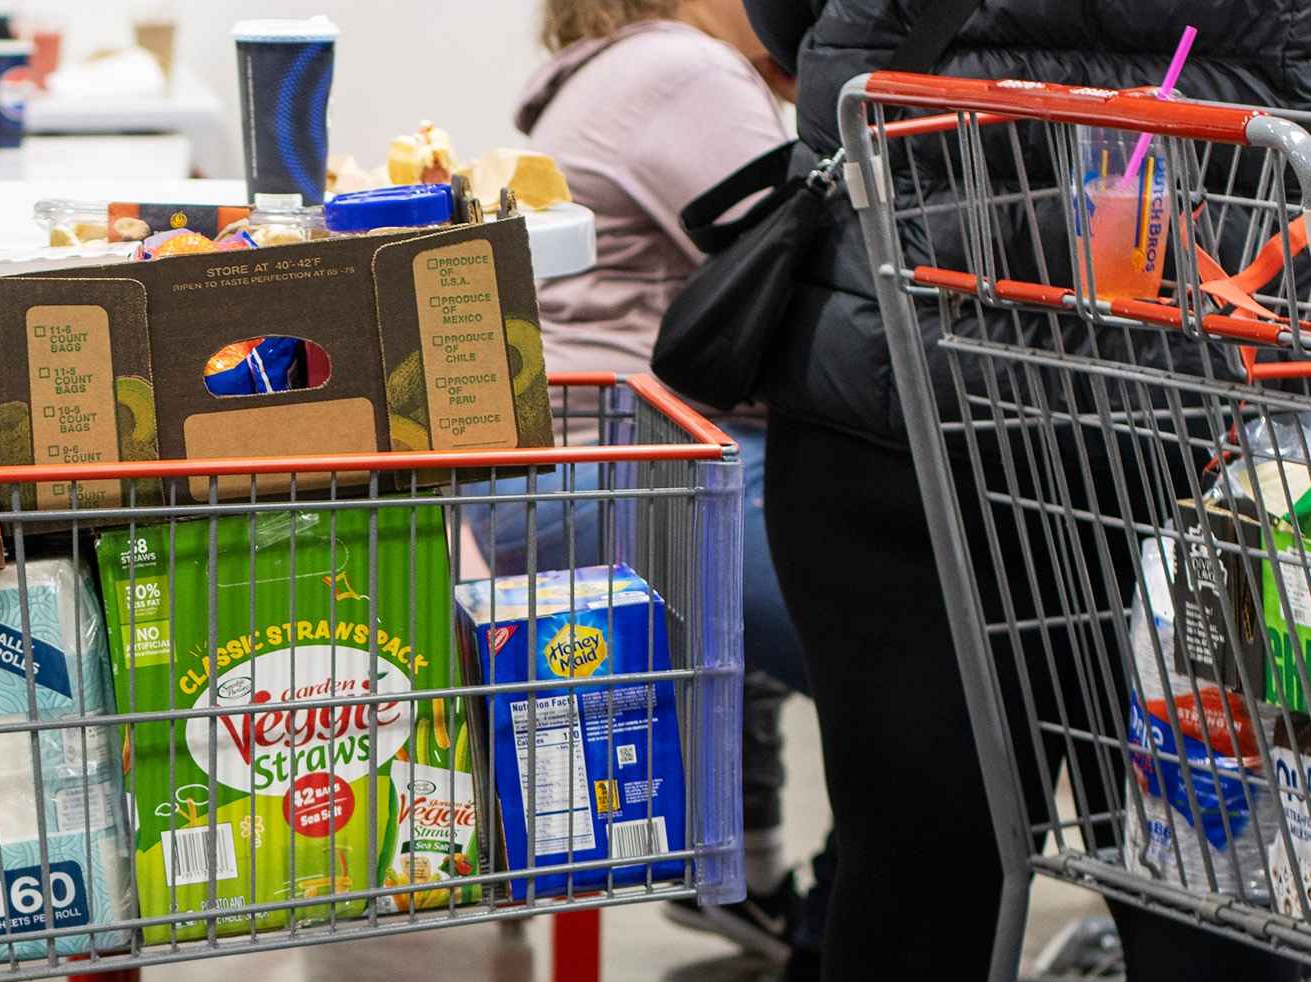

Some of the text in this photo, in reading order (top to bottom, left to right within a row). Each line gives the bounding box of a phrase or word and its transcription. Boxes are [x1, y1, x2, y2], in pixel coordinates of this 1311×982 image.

[1151, 157, 1165, 219] DUTCH
[438, 255, 489, 267] PRODUCE
[206, 264, 249, 278] STORE
[254, 262, 269, 273] AT
[440, 268, 454, 277] OF
[204, 280, 218, 289] TO
[220, 277, 249, 288] TASTE
[250, 271, 311, 285] PERFECTION
[441, 277, 470, 287] U.S.A.
[441, 293, 491, 305] PRODUCE
[443, 306, 457, 315] OF
[443, 314, 483, 325] MEXICO
[50, 332, 87, 344] COUNT
[444, 332, 494, 344] PRODUCE
[50, 343, 82, 353] BAGS
[445, 345, 459, 354] OF
[446, 352, 477, 363] CHILE
[55, 375, 93, 386] COUNT
[447, 373, 498, 386] PRODUCE
[55, 384, 87, 394] BAGS
[448, 386, 462, 396] OF
[449, 395, 476, 406] PERU
[59, 413, 97, 425] COUNT
[451, 414, 501, 426] PRODUCE
[59, 423, 90, 433] BAGS
[452, 427, 466, 436] OF
[64, 452, 102, 464] COUNT
[136, 626, 159, 641] NO
[550, 633, 599, 660] Honey
[179, 620, 428, 694] CLASSIC STRAWS PACK
[560, 650, 598, 672] Maid
[216, 680, 401, 766] Veggie
[254, 734, 371, 789] Straws
[300, 814, 320, 826] Sea
[416, 841, 431, 849] Sea
[33, 913, 51, 923] PE
[55, 908, 81, 920] ROLL
